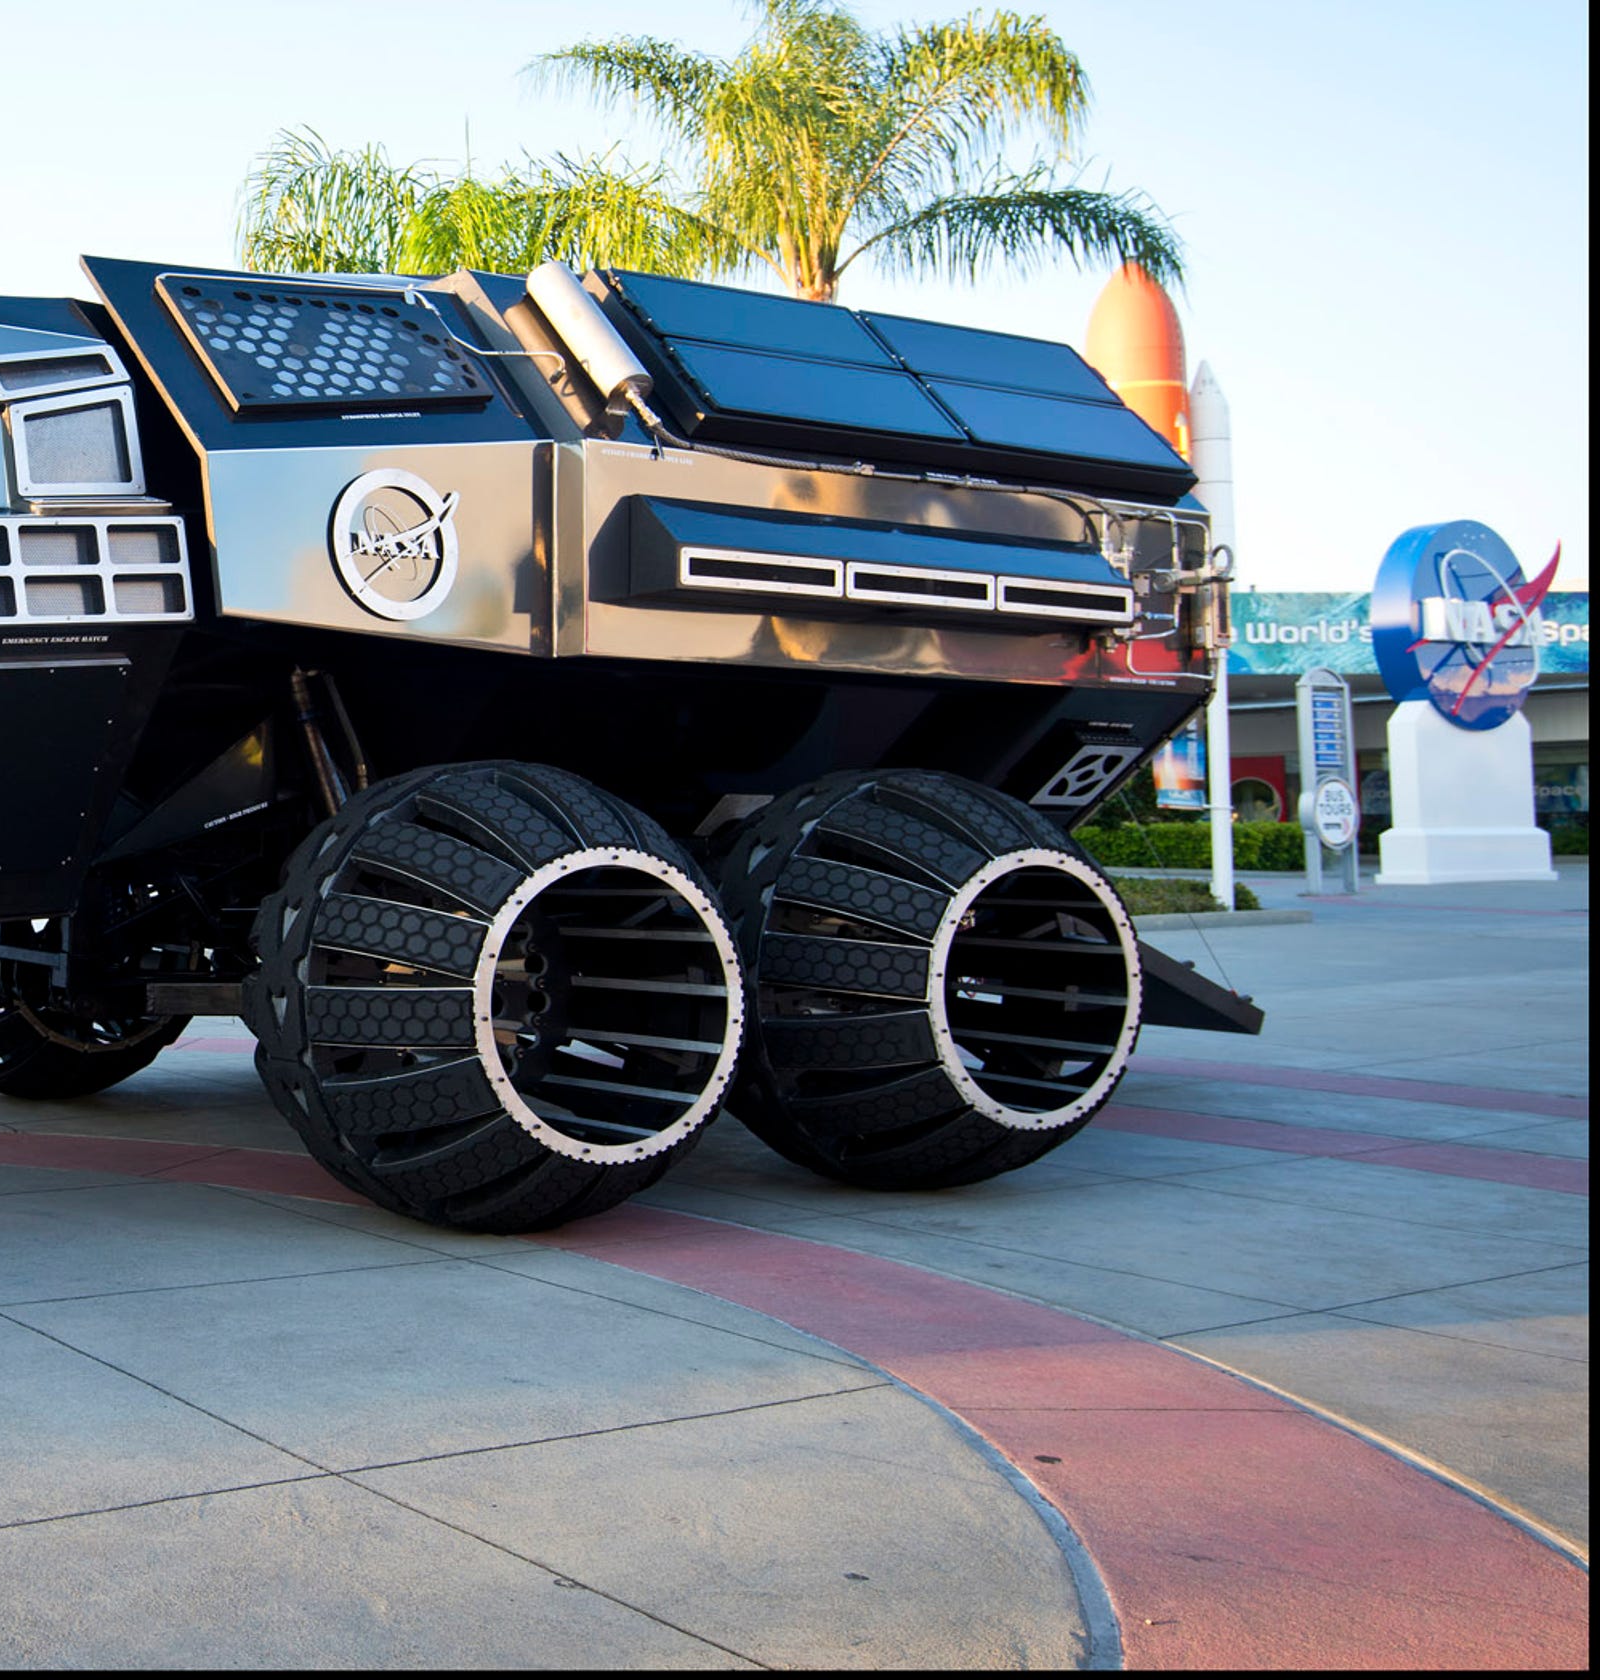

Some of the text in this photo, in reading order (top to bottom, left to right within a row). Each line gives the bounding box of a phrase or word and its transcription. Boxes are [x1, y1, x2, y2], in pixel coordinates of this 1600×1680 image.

[348, 530, 440, 560] NASA
[1424, 597, 1548, 647] NASA
[2, 637, 49, 645] EMERGENCY
[81, 635, 109, 643] HATCH
[1542, 619, 1589, 647] Sp
[1325, 790, 1344, 802] BUS
[1319, 803, 1352, 816] TOURS
